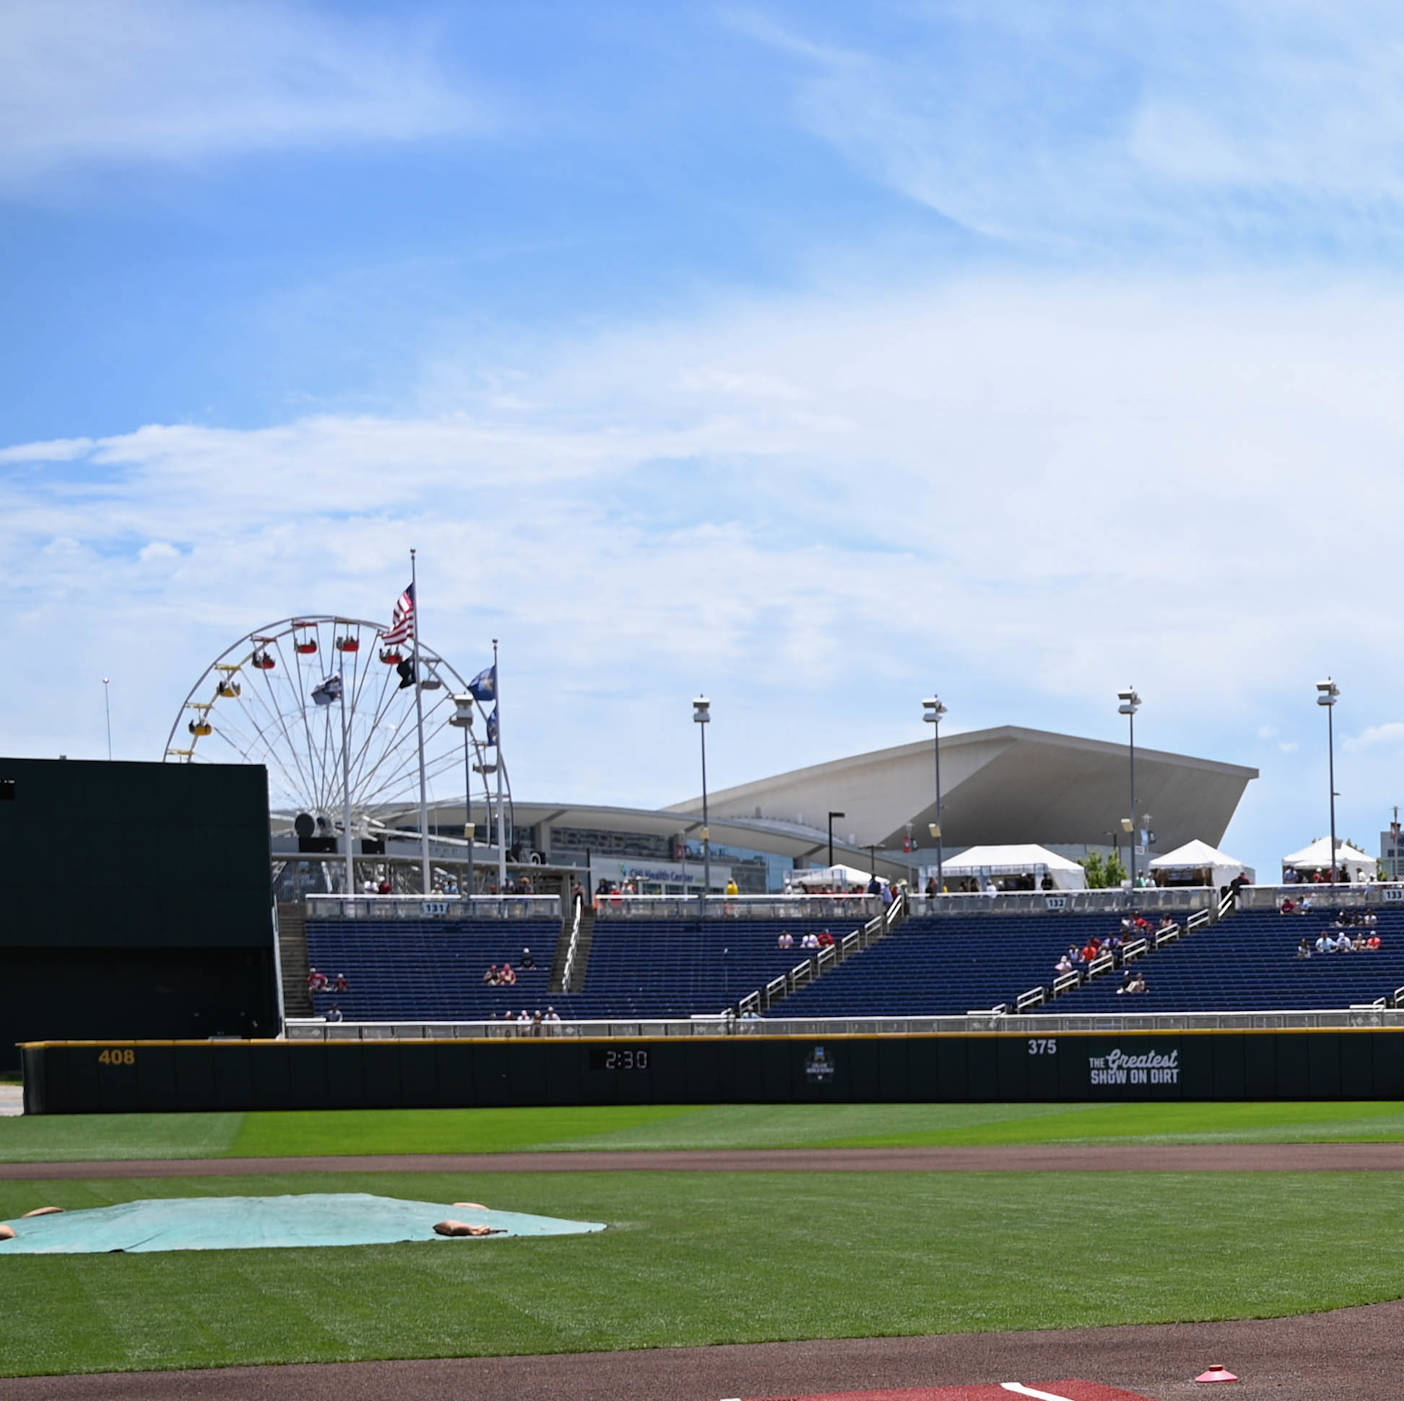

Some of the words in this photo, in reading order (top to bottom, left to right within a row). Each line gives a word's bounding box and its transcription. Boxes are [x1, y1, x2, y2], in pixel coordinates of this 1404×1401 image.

[1387, 891, 1401, 899] 133
[1028, 1039, 1057, 1054] 375
[98, 1049, 135, 1065] 408
[606, 1050, 647, 1069] 2:30
[1089, 1057, 1105, 1068] THE
[1106, 1049, 1178, 1073] Greatest
[1091, 1070, 1126, 1084] SHOW
[1130, 1070, 1147, 1084] ON
[1151, 1069, 1179, 1084] DIRT
